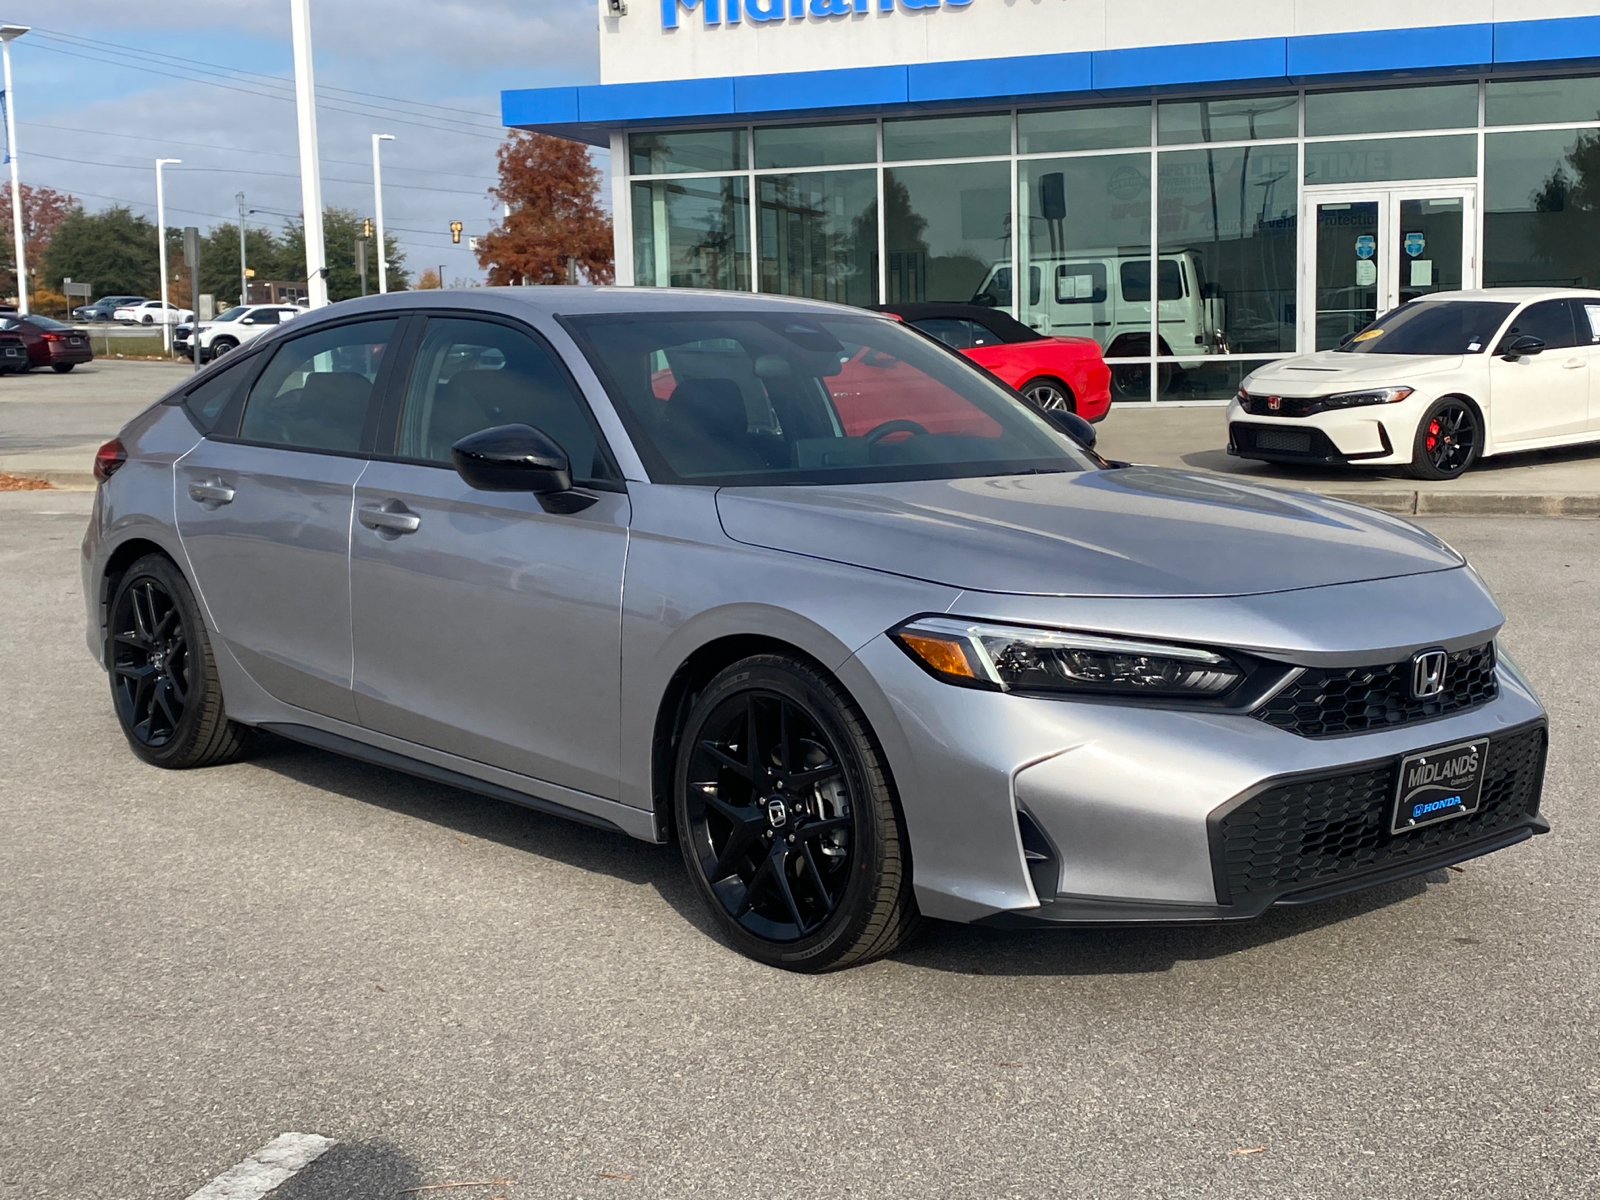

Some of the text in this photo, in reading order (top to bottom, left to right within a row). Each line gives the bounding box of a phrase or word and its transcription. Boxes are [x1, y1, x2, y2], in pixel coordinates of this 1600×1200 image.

[1317, 212, 1377, 226] Protectio
[1407, 753, 1479, 788] MIDLANDS
[1422, 796, 1462, 814] HONDA
